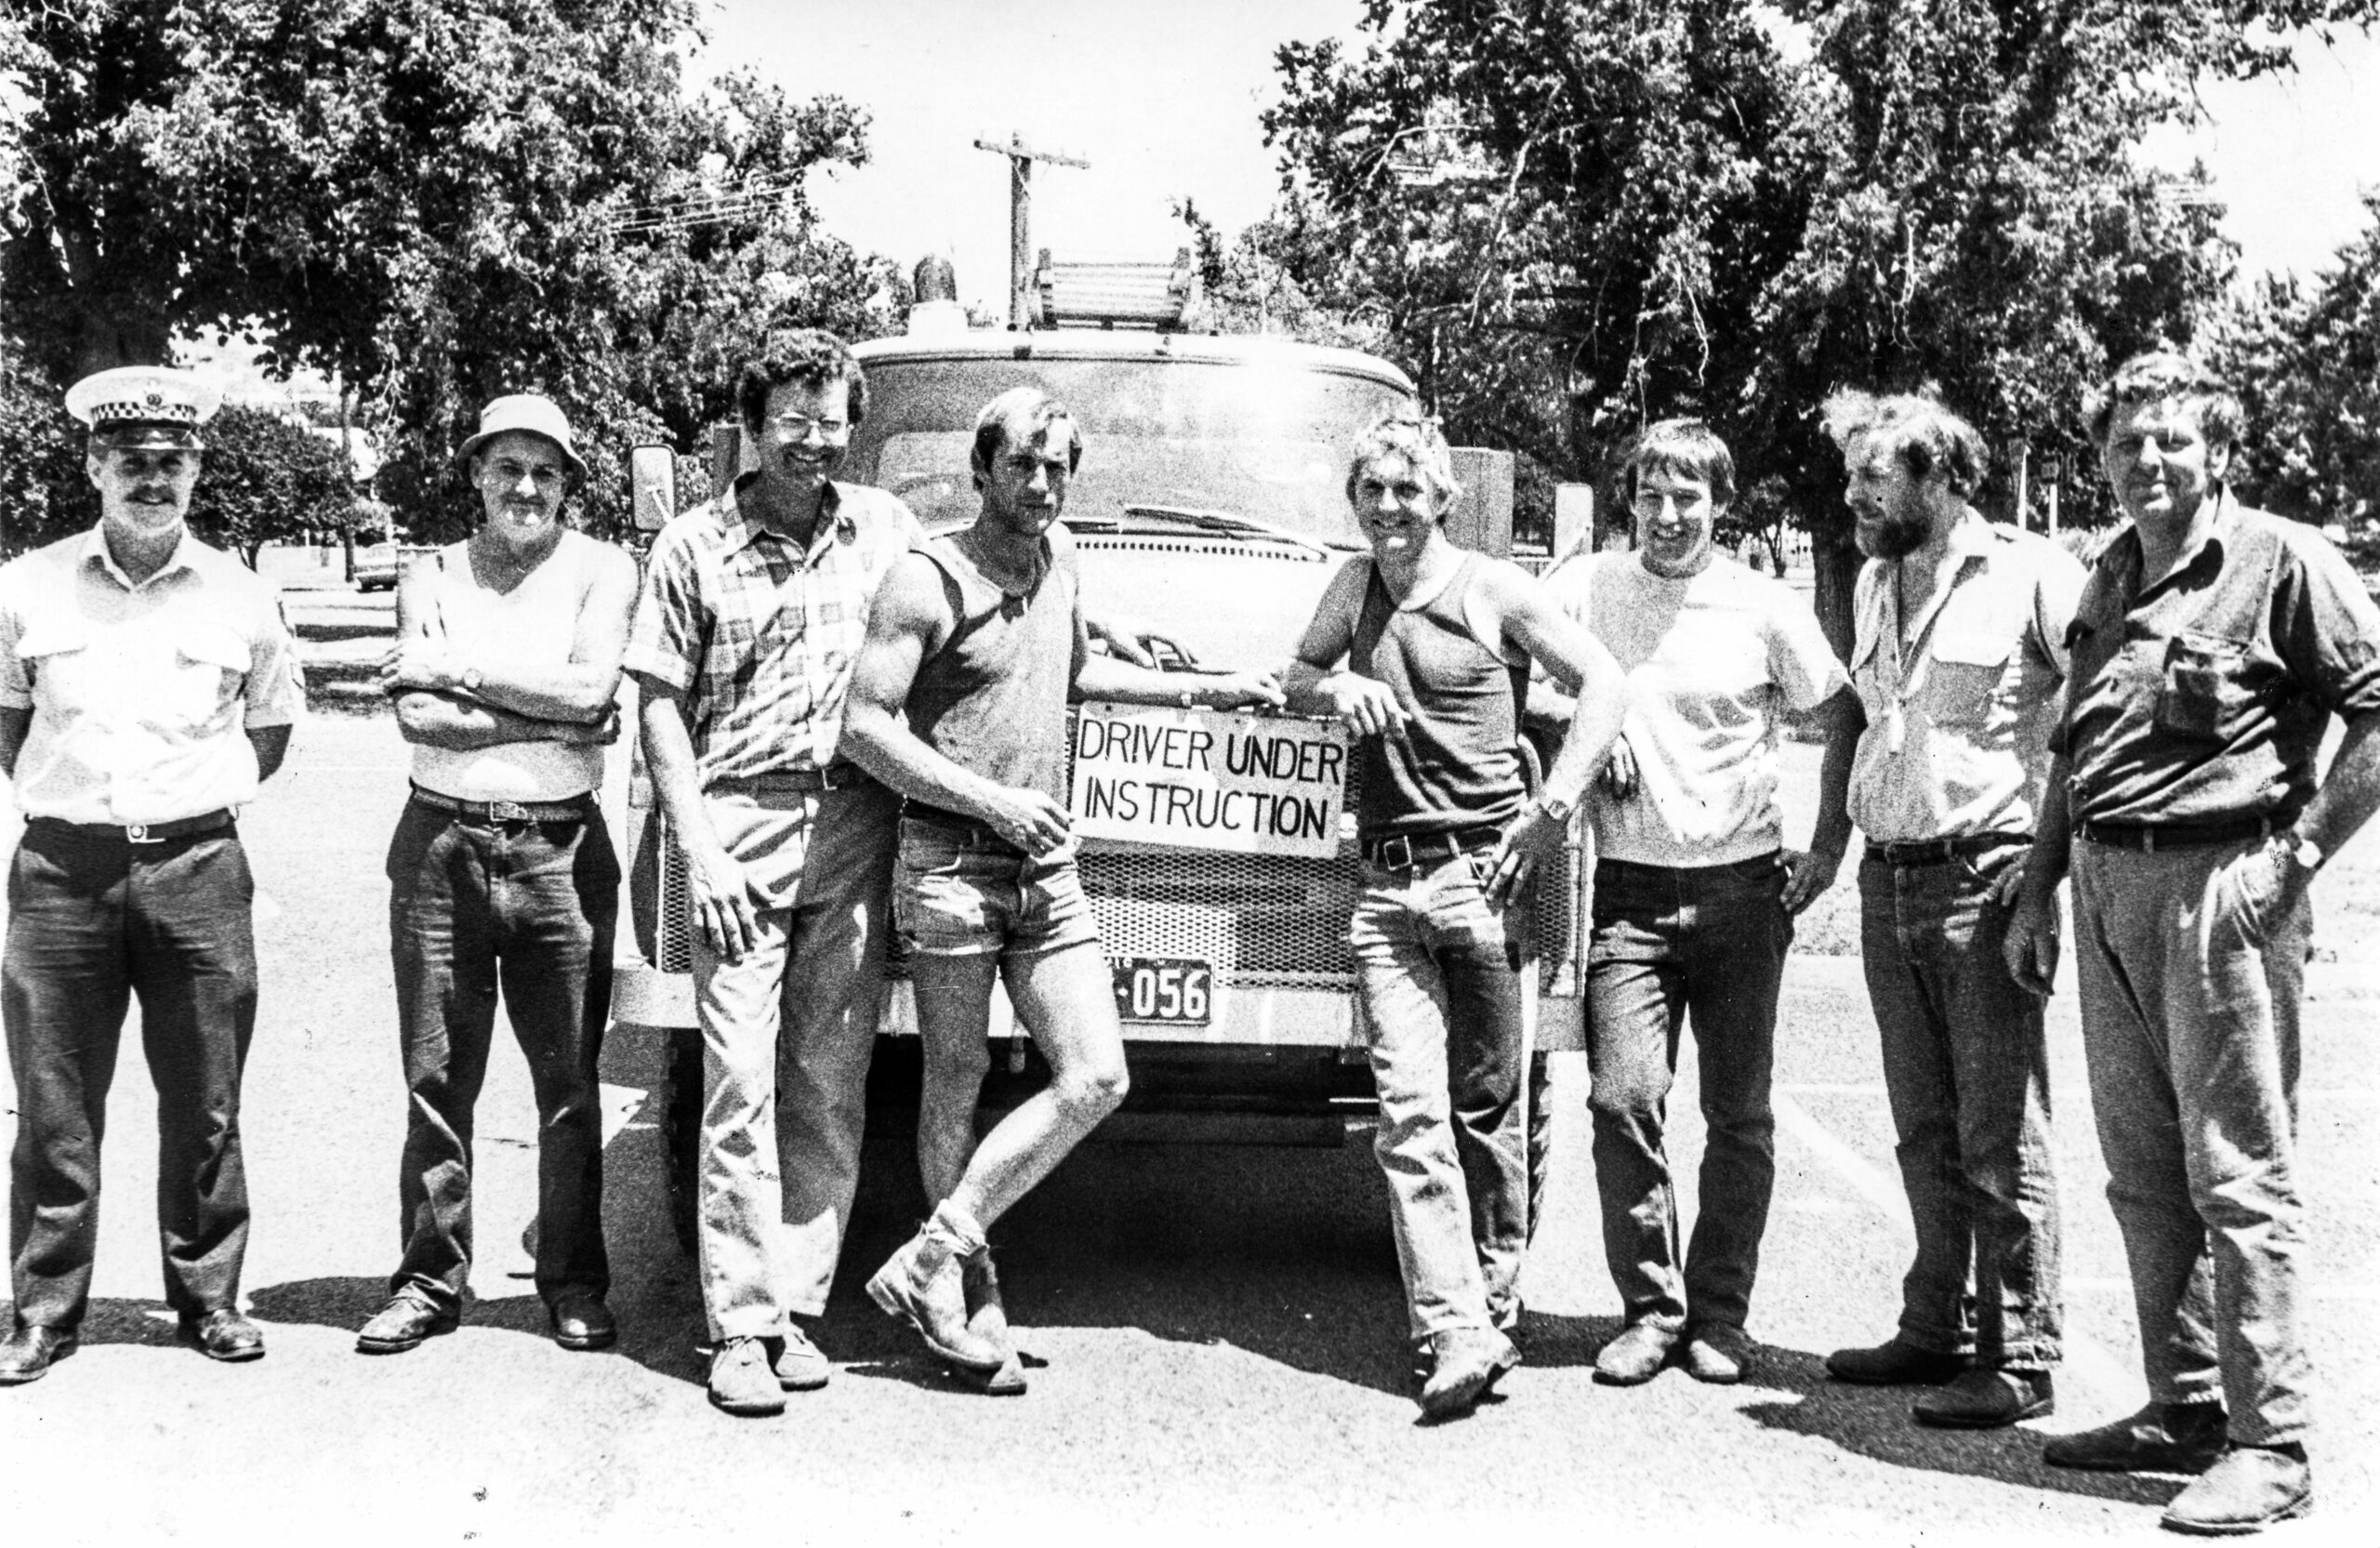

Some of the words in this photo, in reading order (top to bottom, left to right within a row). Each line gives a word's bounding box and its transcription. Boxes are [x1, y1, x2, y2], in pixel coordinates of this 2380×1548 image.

[1078, 719, 1213, 771] DRIVER
[1226, 733, 1343, 786] UNDER
[1085, 775, 1329, 840] INSTRUCTION
